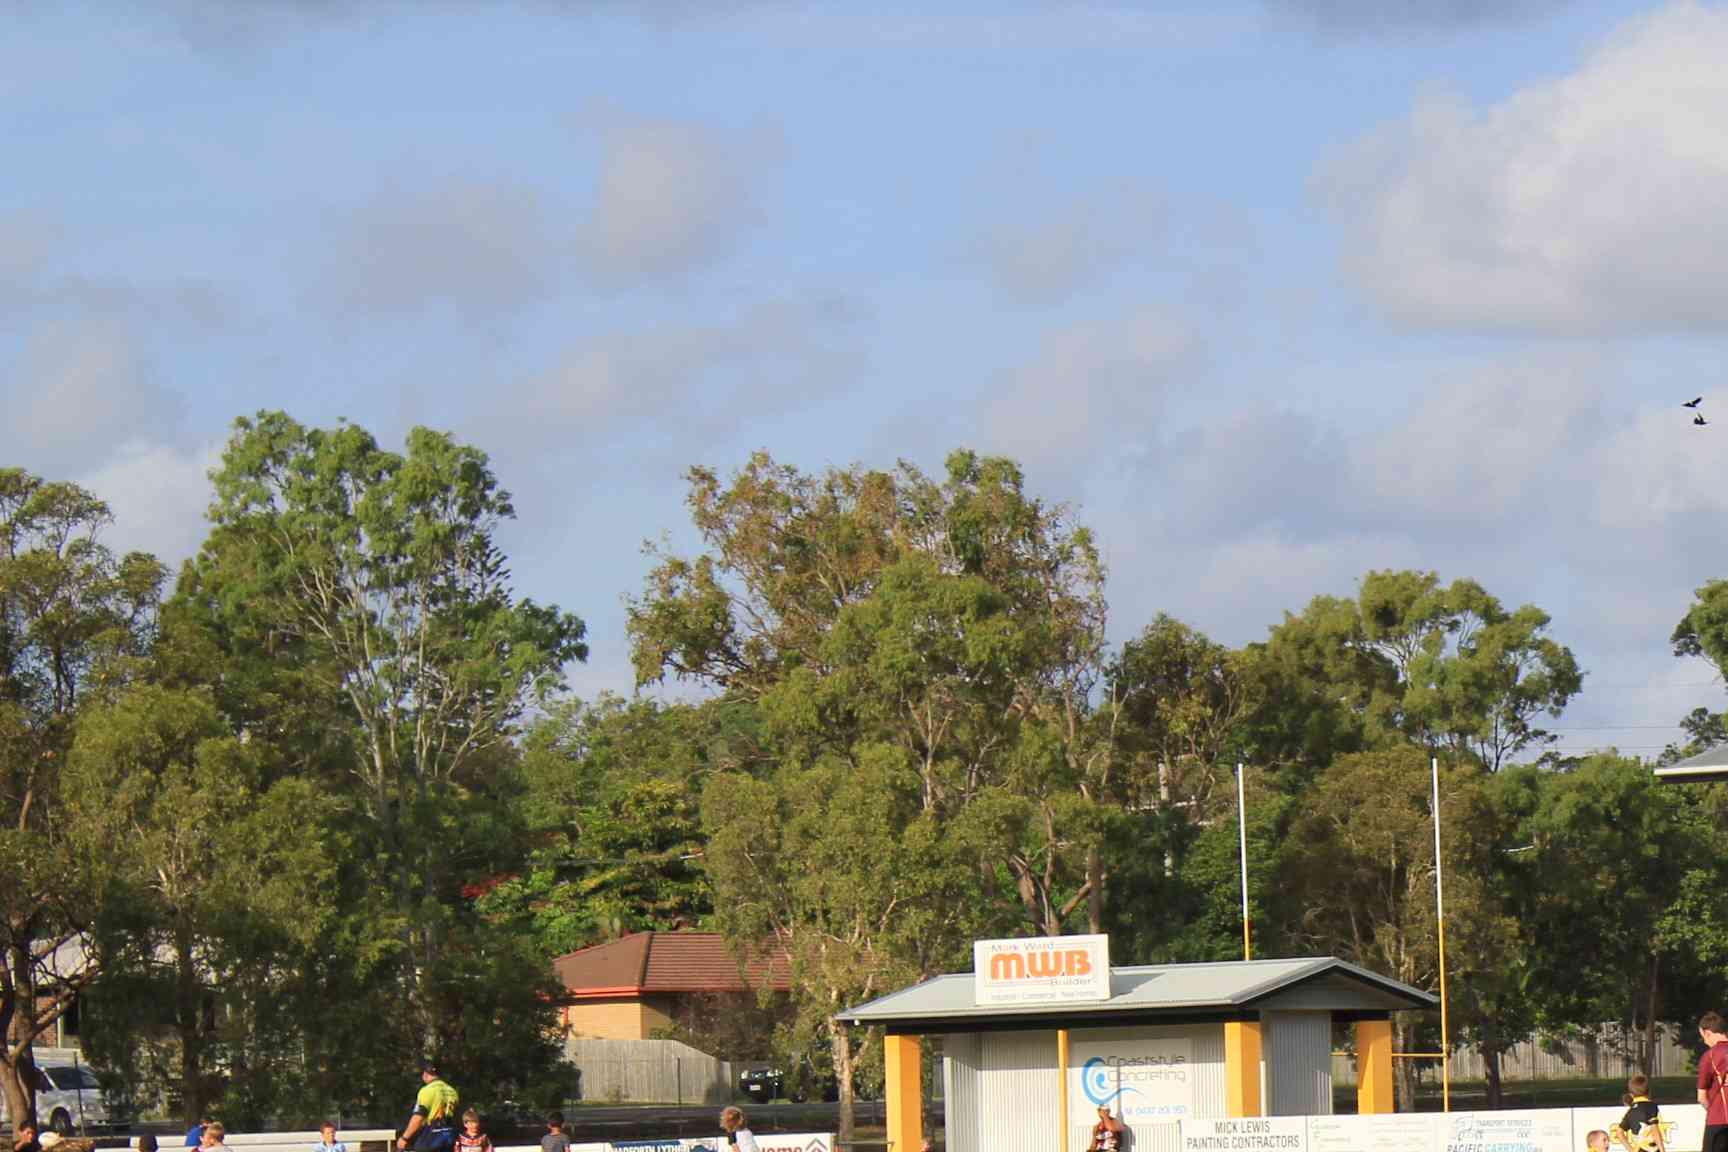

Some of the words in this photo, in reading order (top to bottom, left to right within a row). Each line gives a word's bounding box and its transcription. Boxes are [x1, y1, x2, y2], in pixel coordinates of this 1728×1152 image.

[1215, 1121, 1238, 1135] MICK
[1241, 1119, 1271, 1134] LEWIS
[1186, 1136, 1230, 1150] PAINTING
[1231, 1134, 1300, 1149] CONTRACTORS
